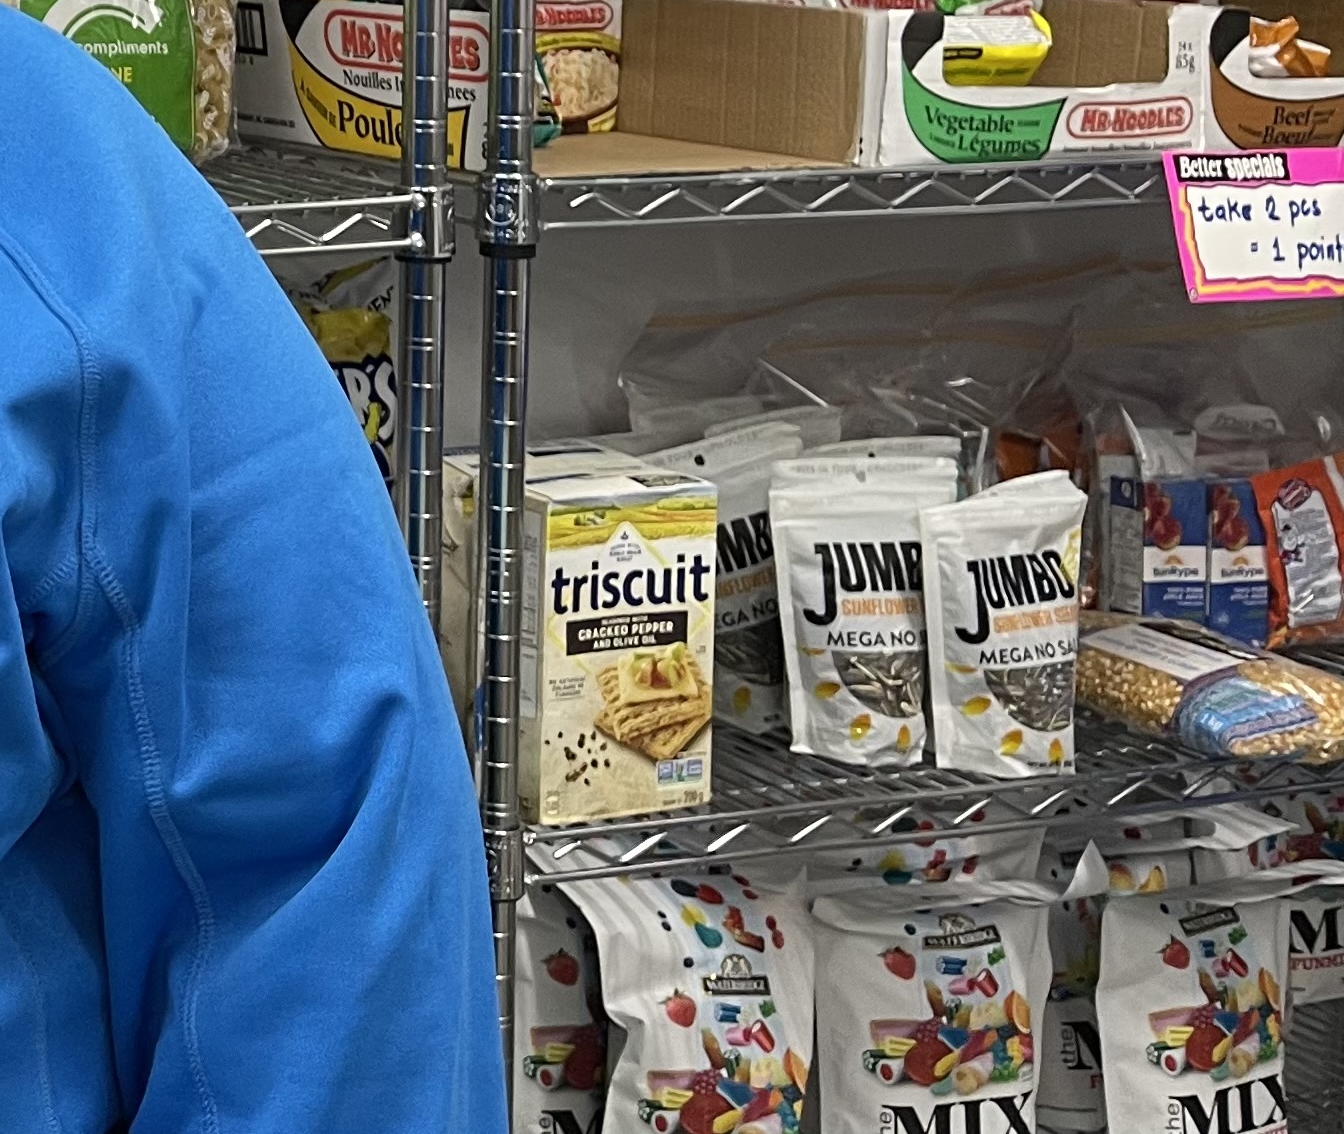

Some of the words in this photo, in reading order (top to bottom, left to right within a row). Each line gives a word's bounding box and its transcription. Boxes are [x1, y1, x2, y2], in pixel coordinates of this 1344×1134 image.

[343, 69, 393, 91] Nouilles
[925, 105, 1014, 136] Vegetable
[1112, 106, 1185, 132] NOODLES
[1273, 105, 1312, 125] Beef
[958, 134, 1042, 158] Légumes
[1179, 154, 1223, 178] Better
[1224, 153, 1285, 181] specials
[1197, 196, 1252, 222] take
[1265, 195, 1281, 221] 2
[1288, 198, 1322, 227] pcs
[1272, 236, 1285, 262] 1
[551, 553, 711, 615] triscuit
[803, 541, 924, 626] JUMB
[955, 549, 1076, 645] JUMBO
[577, 625, 628, 641] CRACKED
[631, 620, 674, 636] PEPPER
[827, 630, 886, 648] MEGA
[891, 629, 916, 647] NO
[979, 645, 1032, 666] MEGA
[1035, 643, 1056, 660] NO
